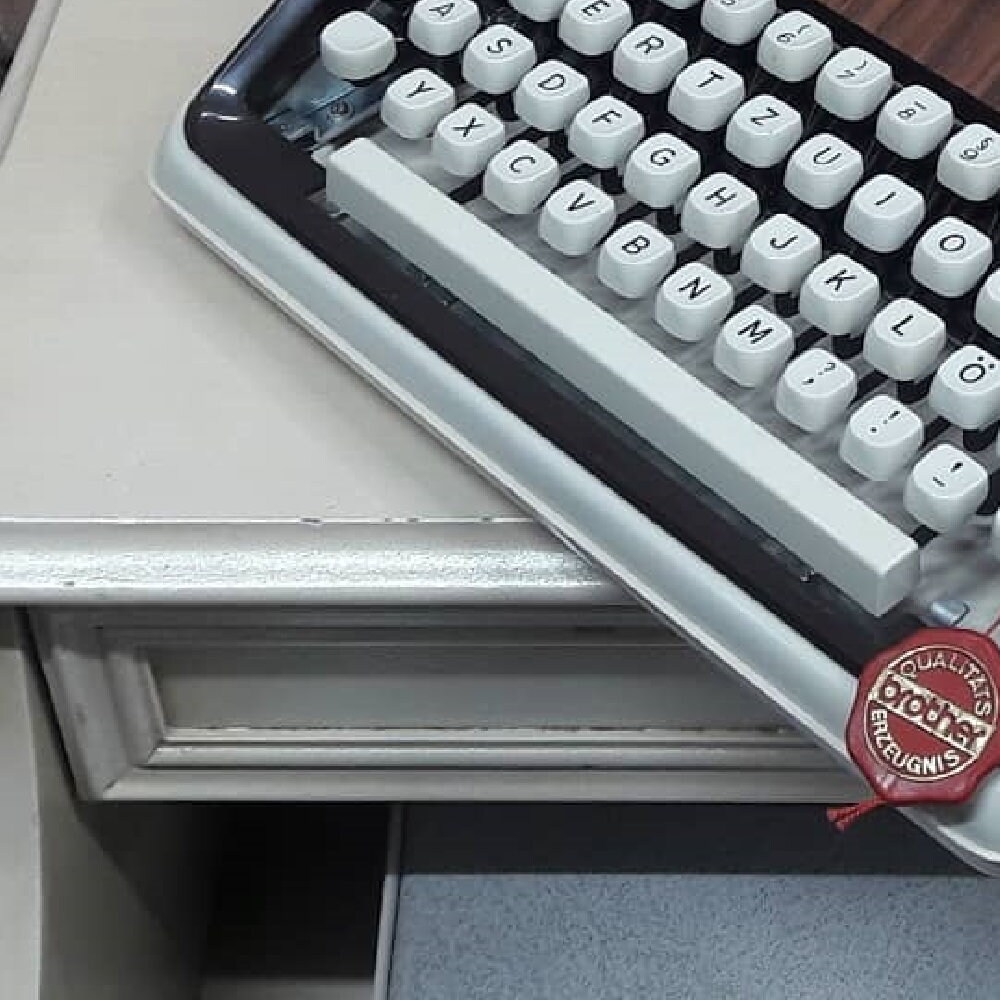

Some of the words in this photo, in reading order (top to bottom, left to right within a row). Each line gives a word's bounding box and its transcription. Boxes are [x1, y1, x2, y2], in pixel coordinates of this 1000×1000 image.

[429, 3, 455, 16] A
[581, 0, 611, 16] E
[487, 38, 513, 53] S
[635, 35, 664, 53] R
[538, 74, 566, 90] D
[698, 70, 724, 87] T
[407, 81, 430, 98] Y
[592, 109, 622, 124] F
[751, 107, 779, 125] Z
[453, 118, 485, 137] X
[509, 155, 535, 173] C
[650, 148, 676, 166] G
[813, 148, 841, 164] U
[568, 192, 594, 211] V
[705, 187, 737, 207] H
[876, 192, 896, 205] I
[622, 235, 650, 253] B
[770, 235, 798, 250] J
[940, 235, 966, 251] O
[679, 277, 711, 300] N
[825, 270, 857, 291] K
[738, 320, 772, 344] M
[892, 314, 913, 335] L
[960, 355, 995, 383] Ö
[877, 674, 987, 750] brother
[871, 709, 960, 775] ERZEUGNIS
